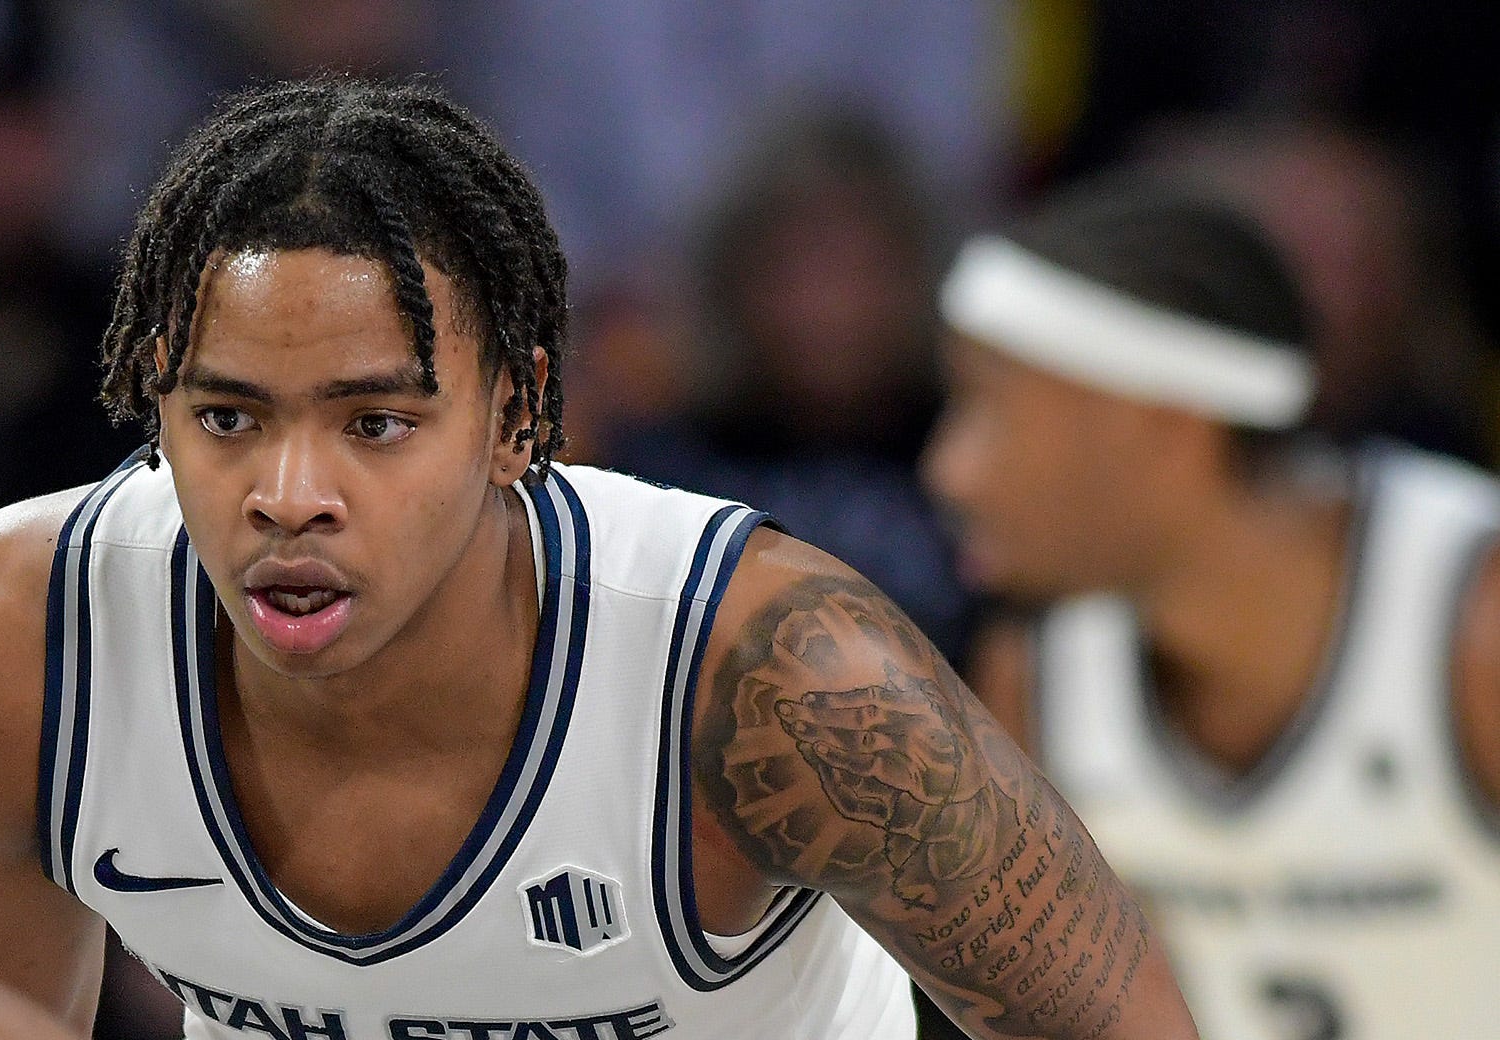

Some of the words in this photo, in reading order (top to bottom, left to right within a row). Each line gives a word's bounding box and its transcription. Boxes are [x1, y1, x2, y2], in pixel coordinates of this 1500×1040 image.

[915, 906, 971, 949] Now
[973, 885, 990, 908] is
[990, 828, 1027, 893] your
[941, 941, 966, 970] of
[970, 894, 1021, 960] grief,
[1017, 855, 1049, 898] but
[1044, 833, 1056, 859] I
[987, 945, 1020, 980] see
[1020, 901, 1056, 956] you
[1017, 942, 1057, 995] and
[1058, 903, 1084, 957] you
